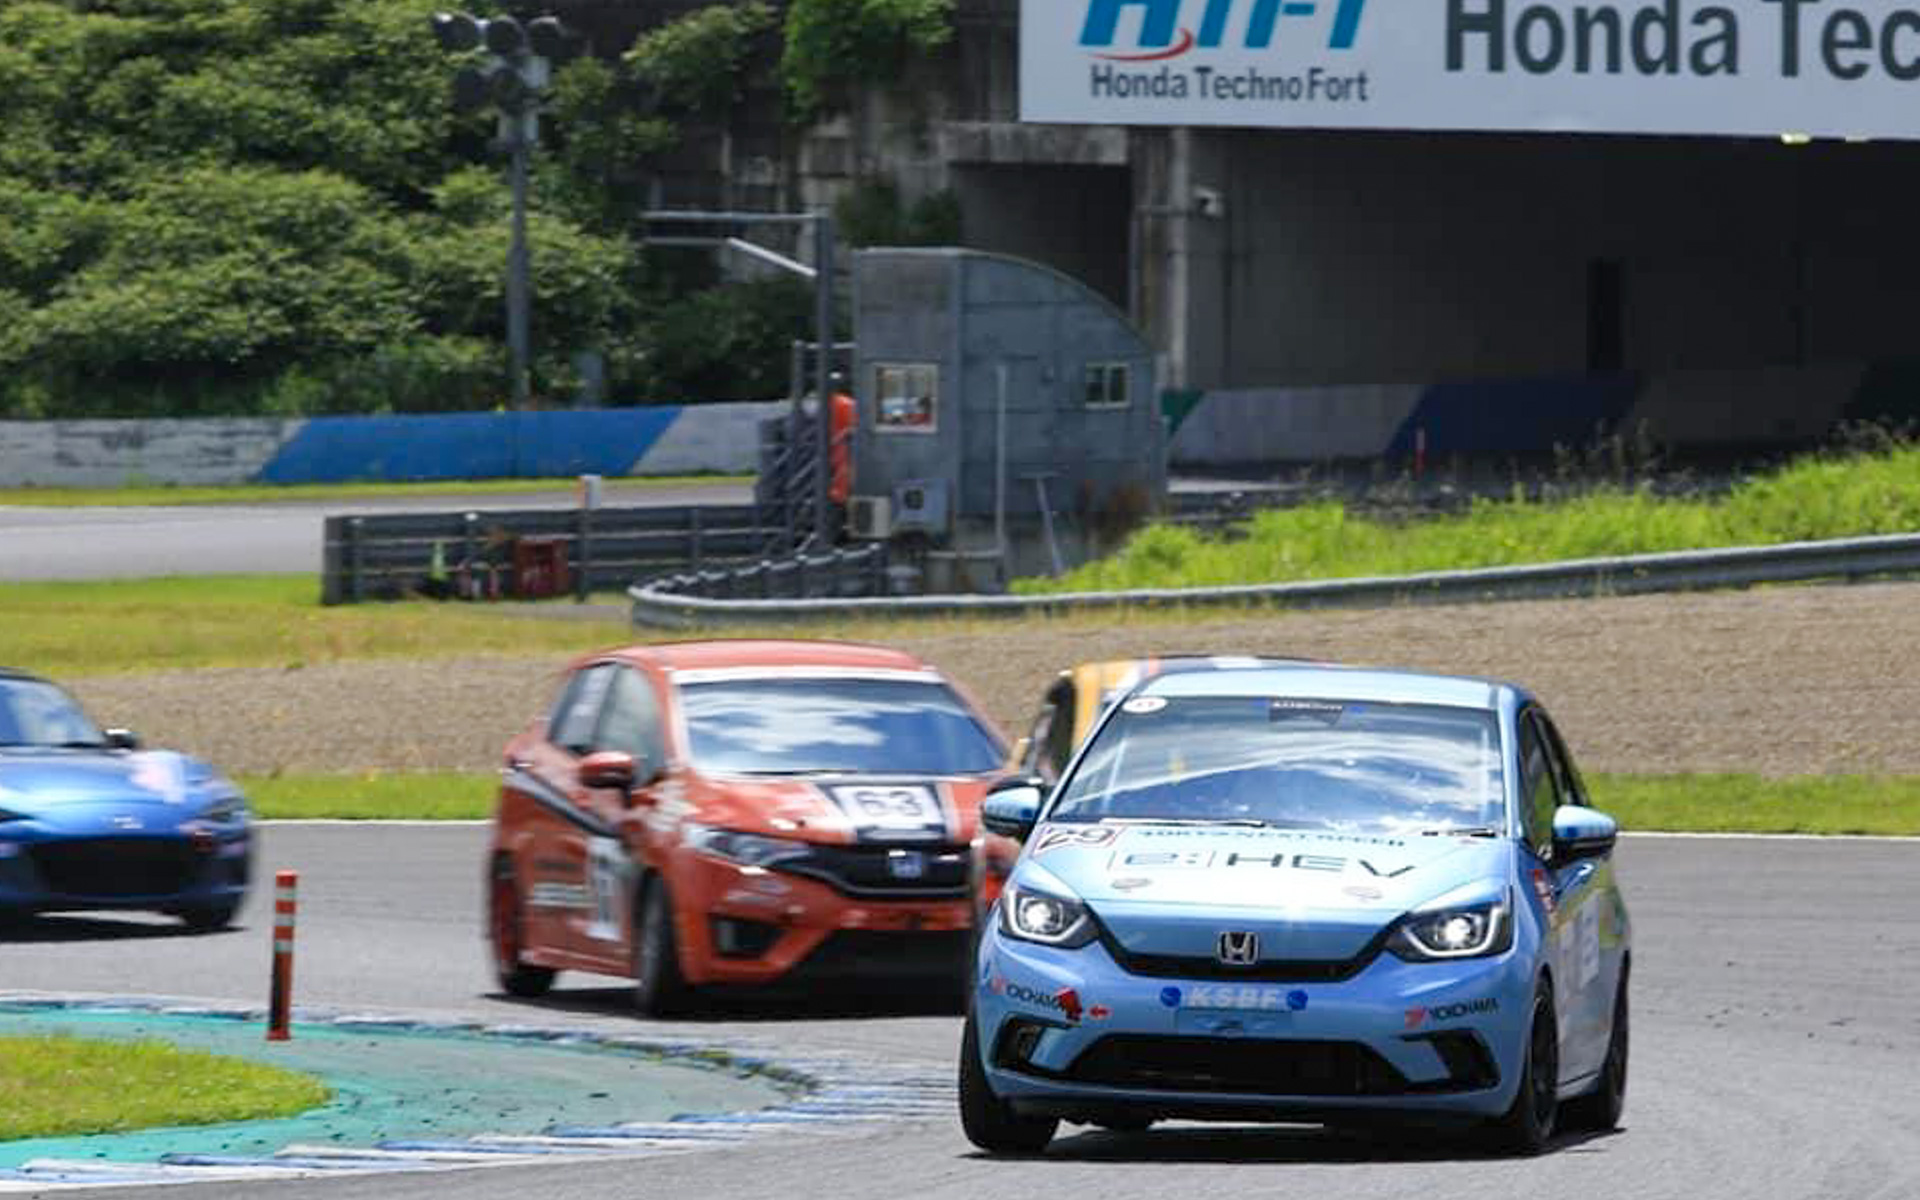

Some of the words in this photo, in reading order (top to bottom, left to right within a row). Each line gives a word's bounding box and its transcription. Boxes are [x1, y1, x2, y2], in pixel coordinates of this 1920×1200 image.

[1445, 0, 1738, 75] Honda
[1762, 0, 1920, 81] Tec
[1091, 65, 1187, 98] Honda
[1194, 66, 1302, 100] Techno
[1308, 68, 1368, 101] Fort
[856, 790, 922, 817] 63
